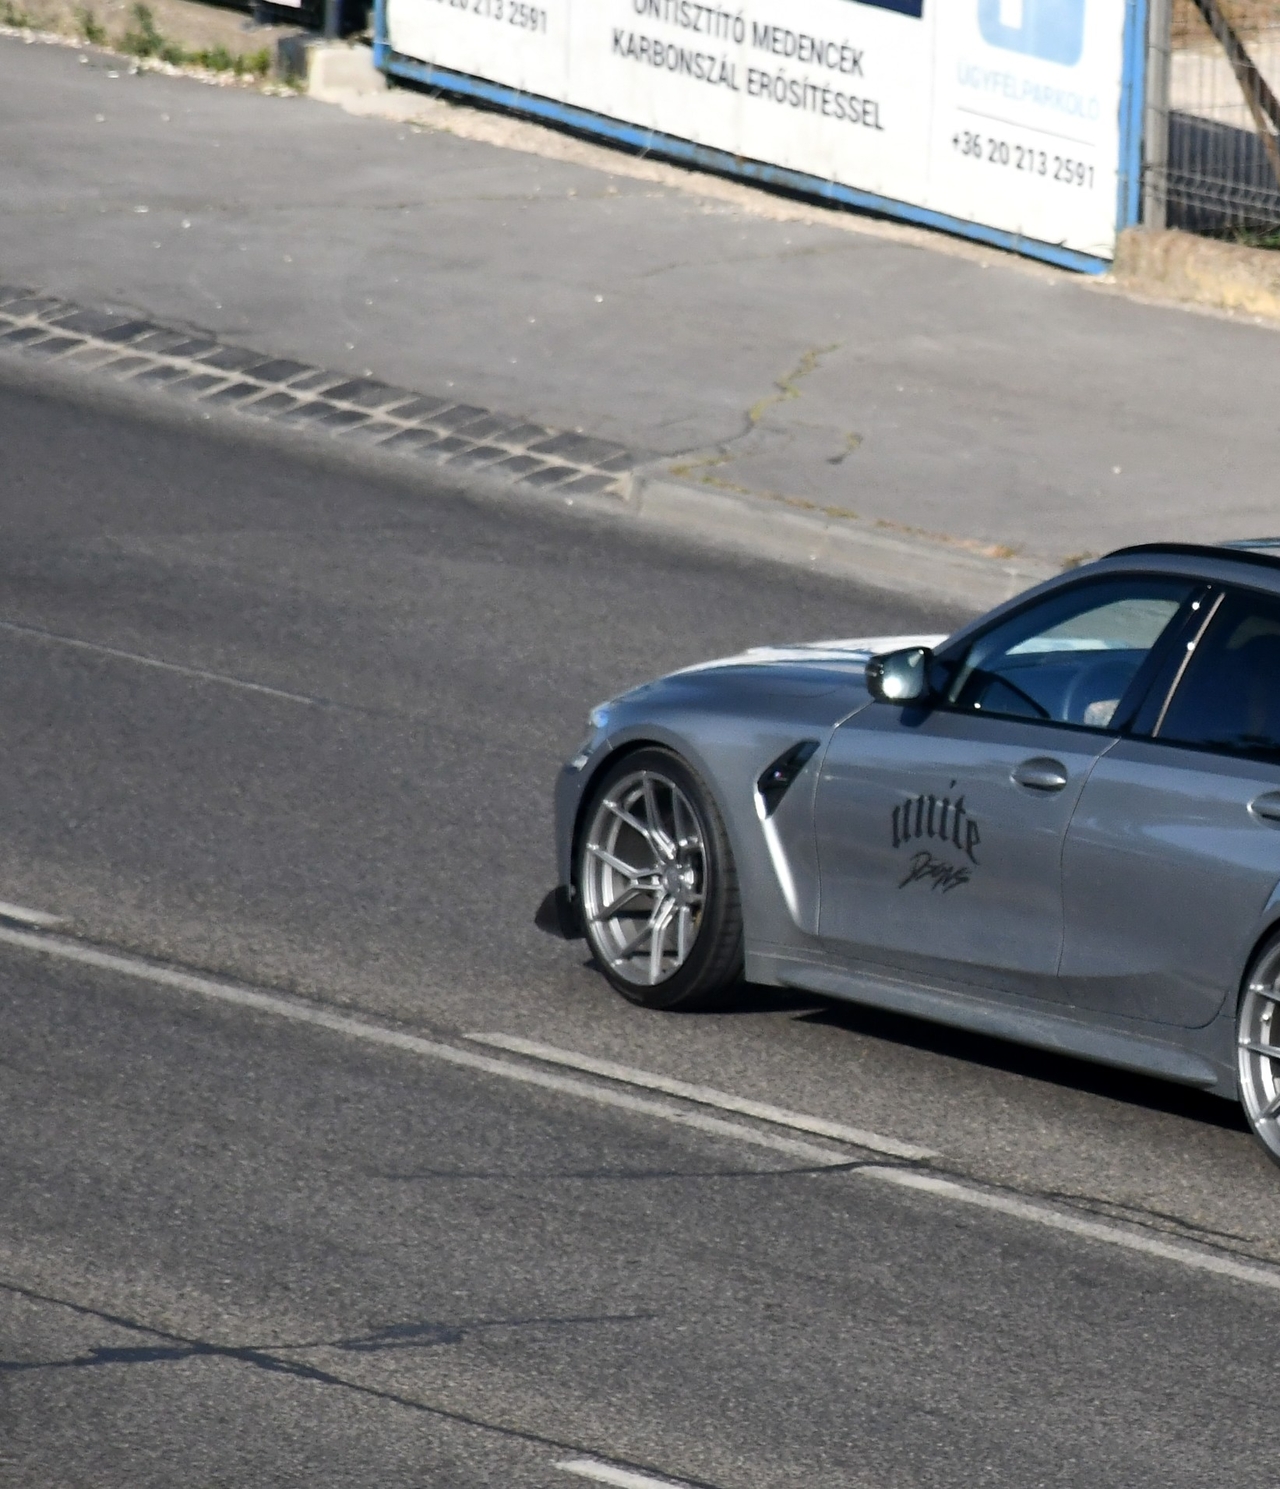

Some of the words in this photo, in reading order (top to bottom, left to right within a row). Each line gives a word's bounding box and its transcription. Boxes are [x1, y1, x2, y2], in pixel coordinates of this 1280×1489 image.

[509, 1, 548, 33] 2591
[752, 21, 865, 77] MEDENCÉK
[612, 28, 740, 91] KARBONSZÁL
[747, 67, 885, 130] ERŐSÍTÉSSEL
[952, 131, 982, 159] +36
[988, 138, 1010, 166] 20
[1015, 145, 1048, 176] 213
[1053, 155, 1095, 190] 2591
